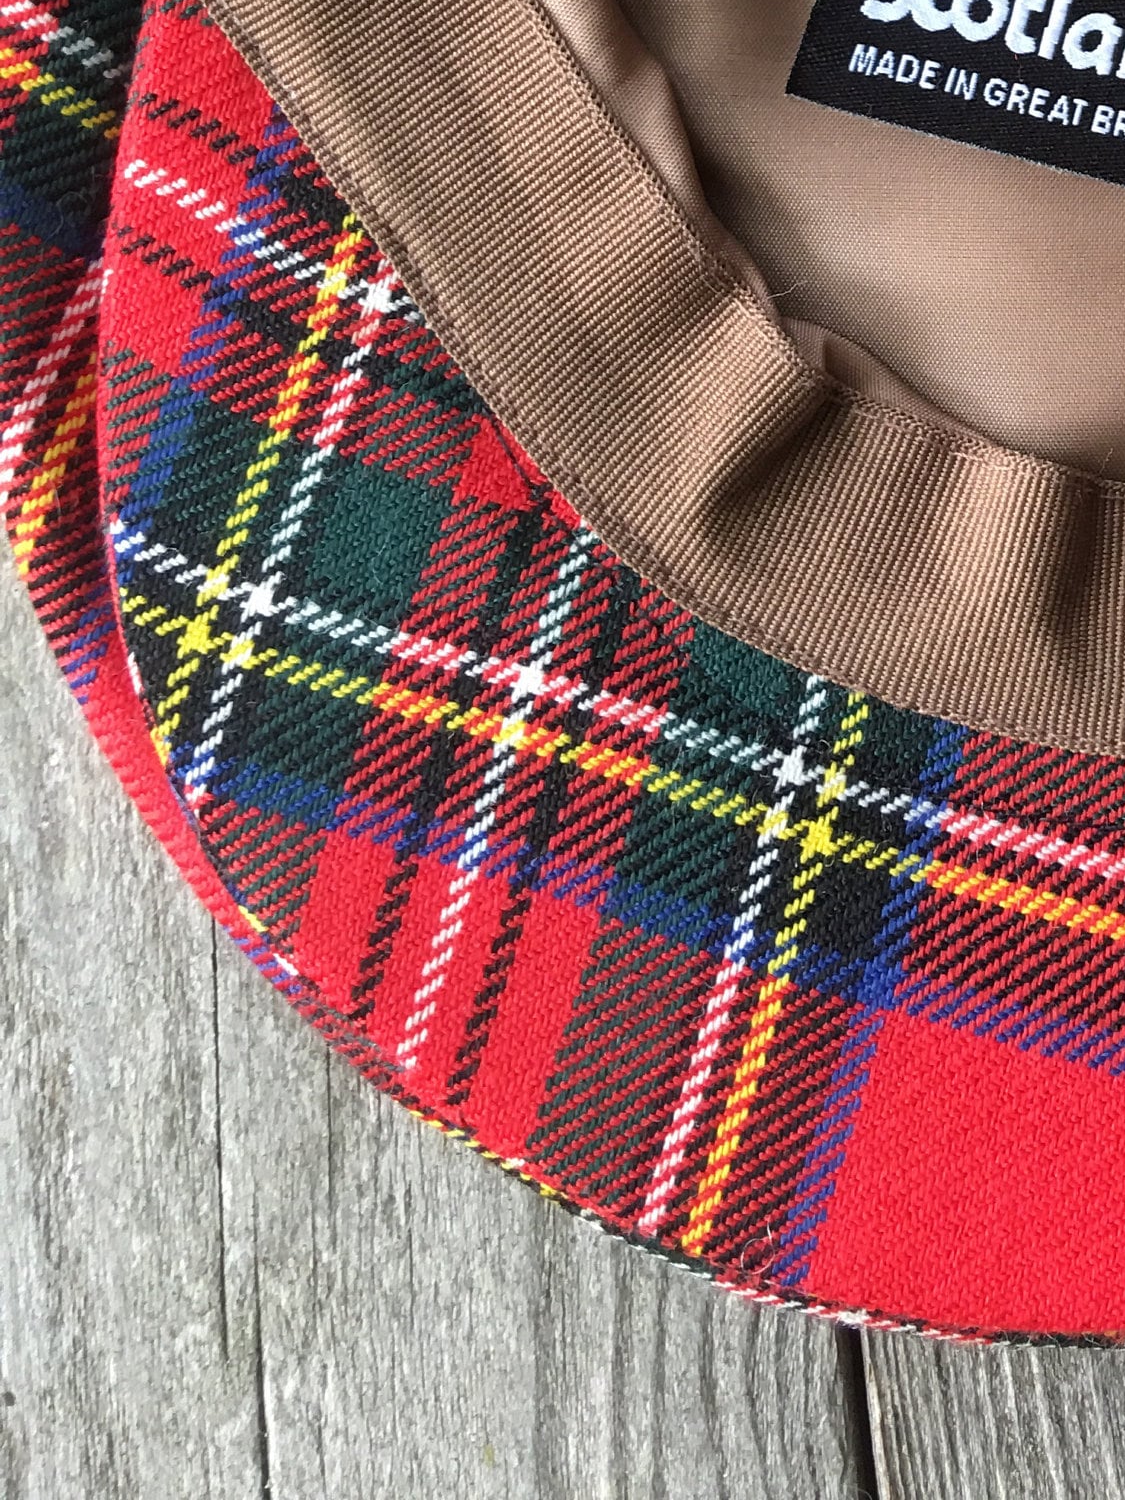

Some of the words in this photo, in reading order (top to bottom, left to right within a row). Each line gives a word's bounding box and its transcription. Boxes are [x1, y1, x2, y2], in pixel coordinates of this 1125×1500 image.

[848, 43, 941, 90] MADE
[944, 67, 979, 100] IN
[984, 78, 1089, 126] GREAT
